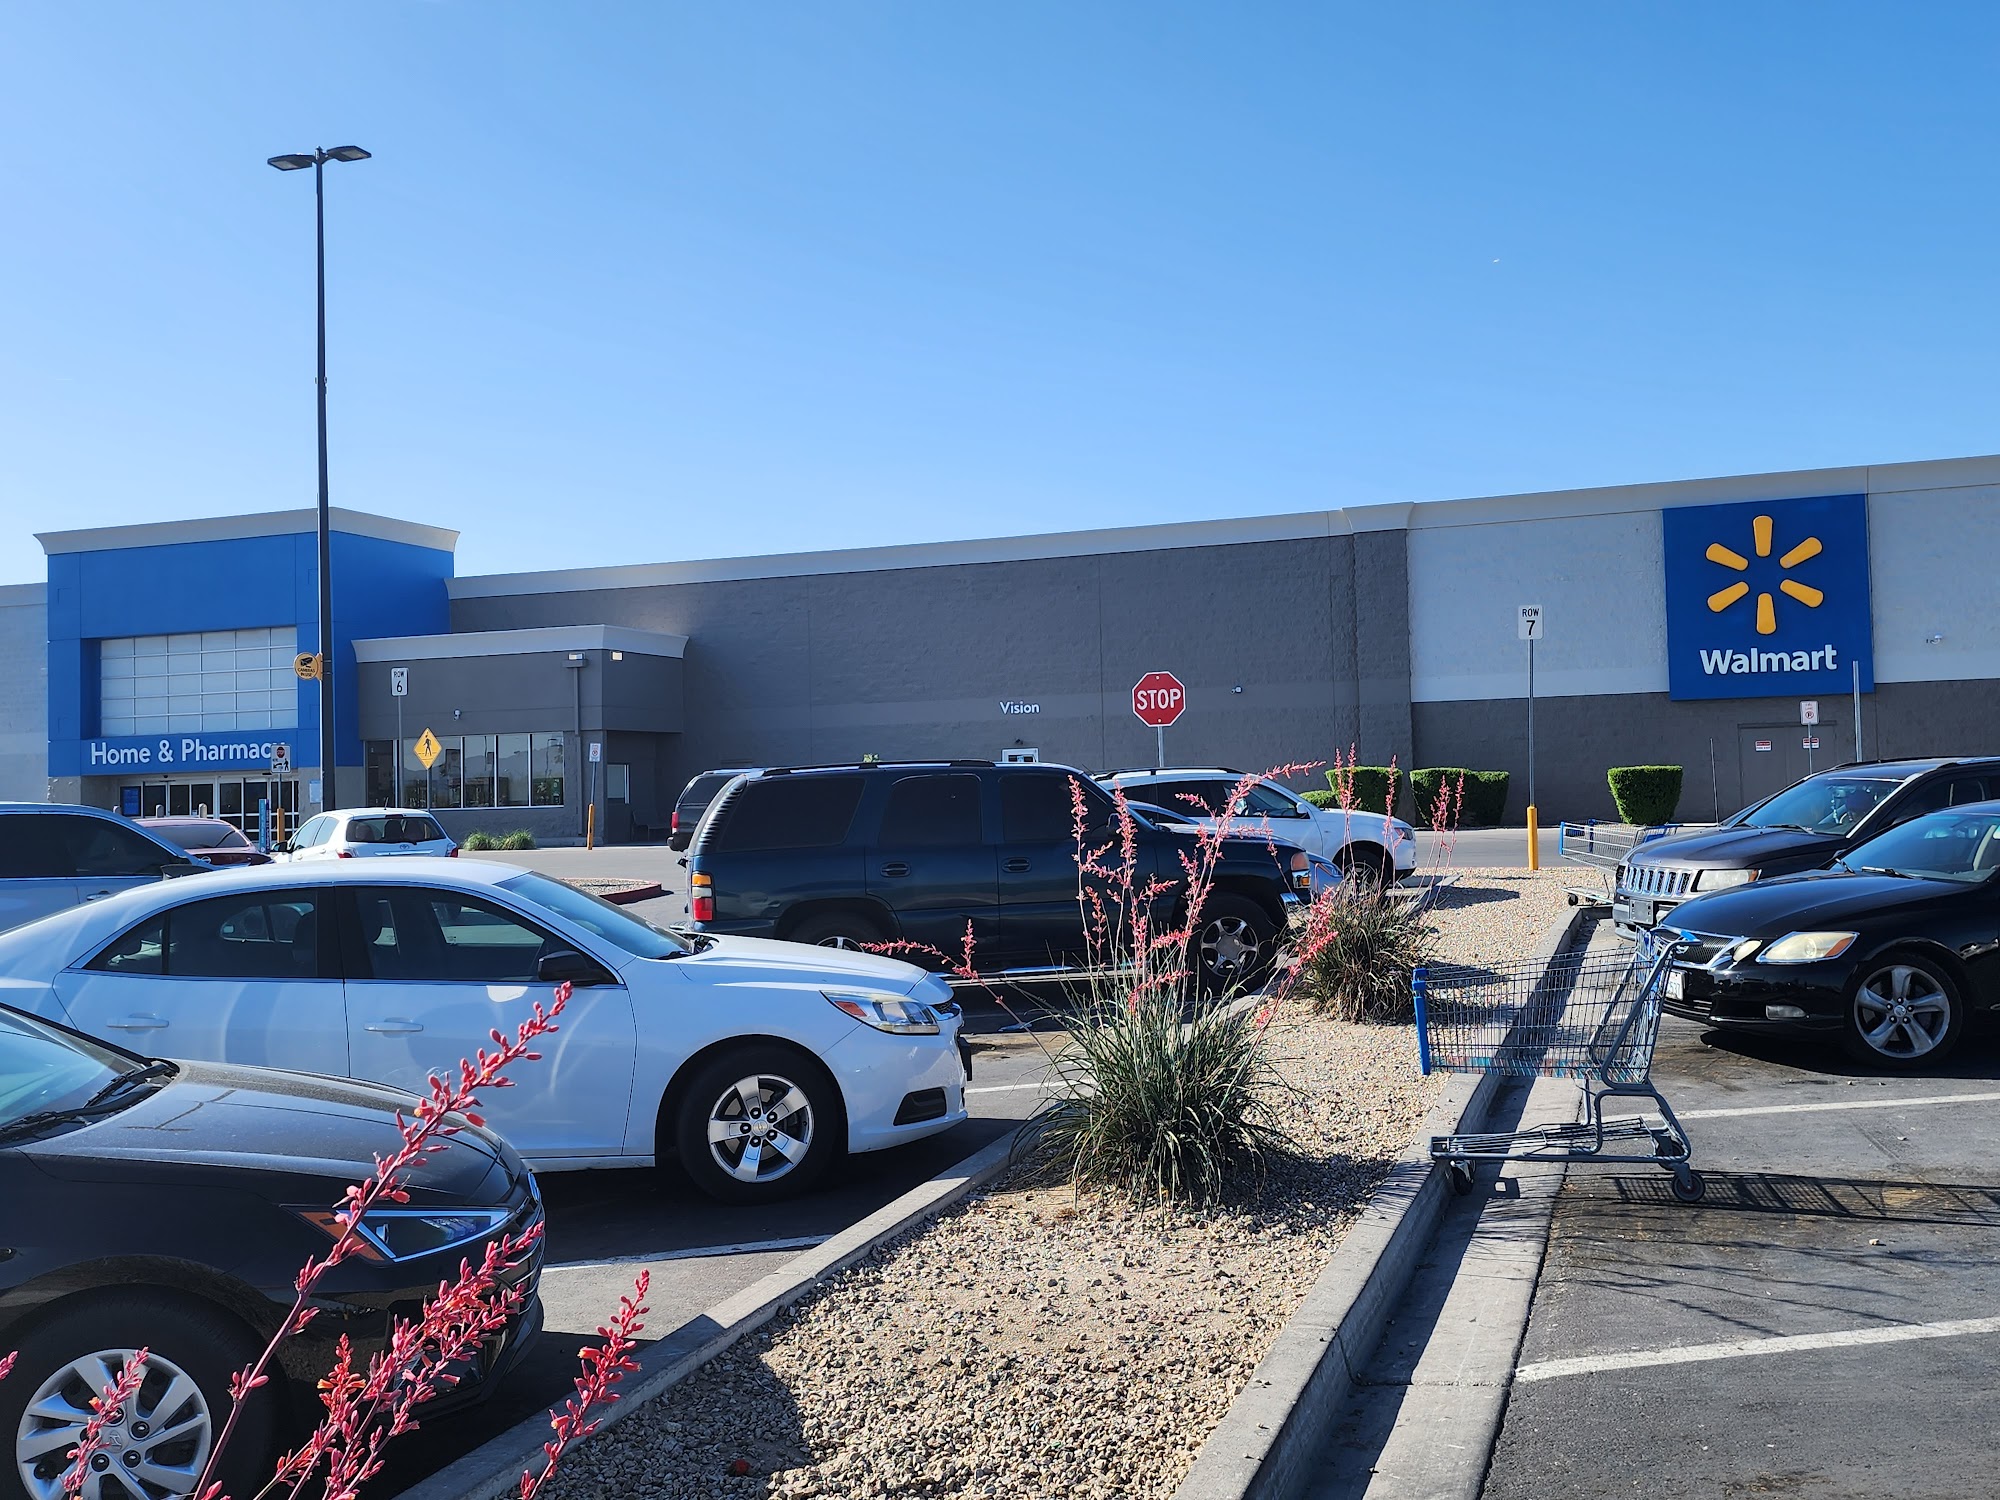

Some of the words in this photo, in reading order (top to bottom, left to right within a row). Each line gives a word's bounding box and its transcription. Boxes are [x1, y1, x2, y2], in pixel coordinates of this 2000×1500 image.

[1522, 608, 1540, 617] ROW
[1526, 620, 1535, 636] 7
[1699, 644, 1837, 675] Walmart
[396, 681, 403, 693] 6
[999, 700, 1040, 714] Vision
[1136, 688, 1182, 710] STOP
[90, 742, 151, 765] Home
[157, 740, 174, 763] &
[181, 739, 285, 762] Pharmac
